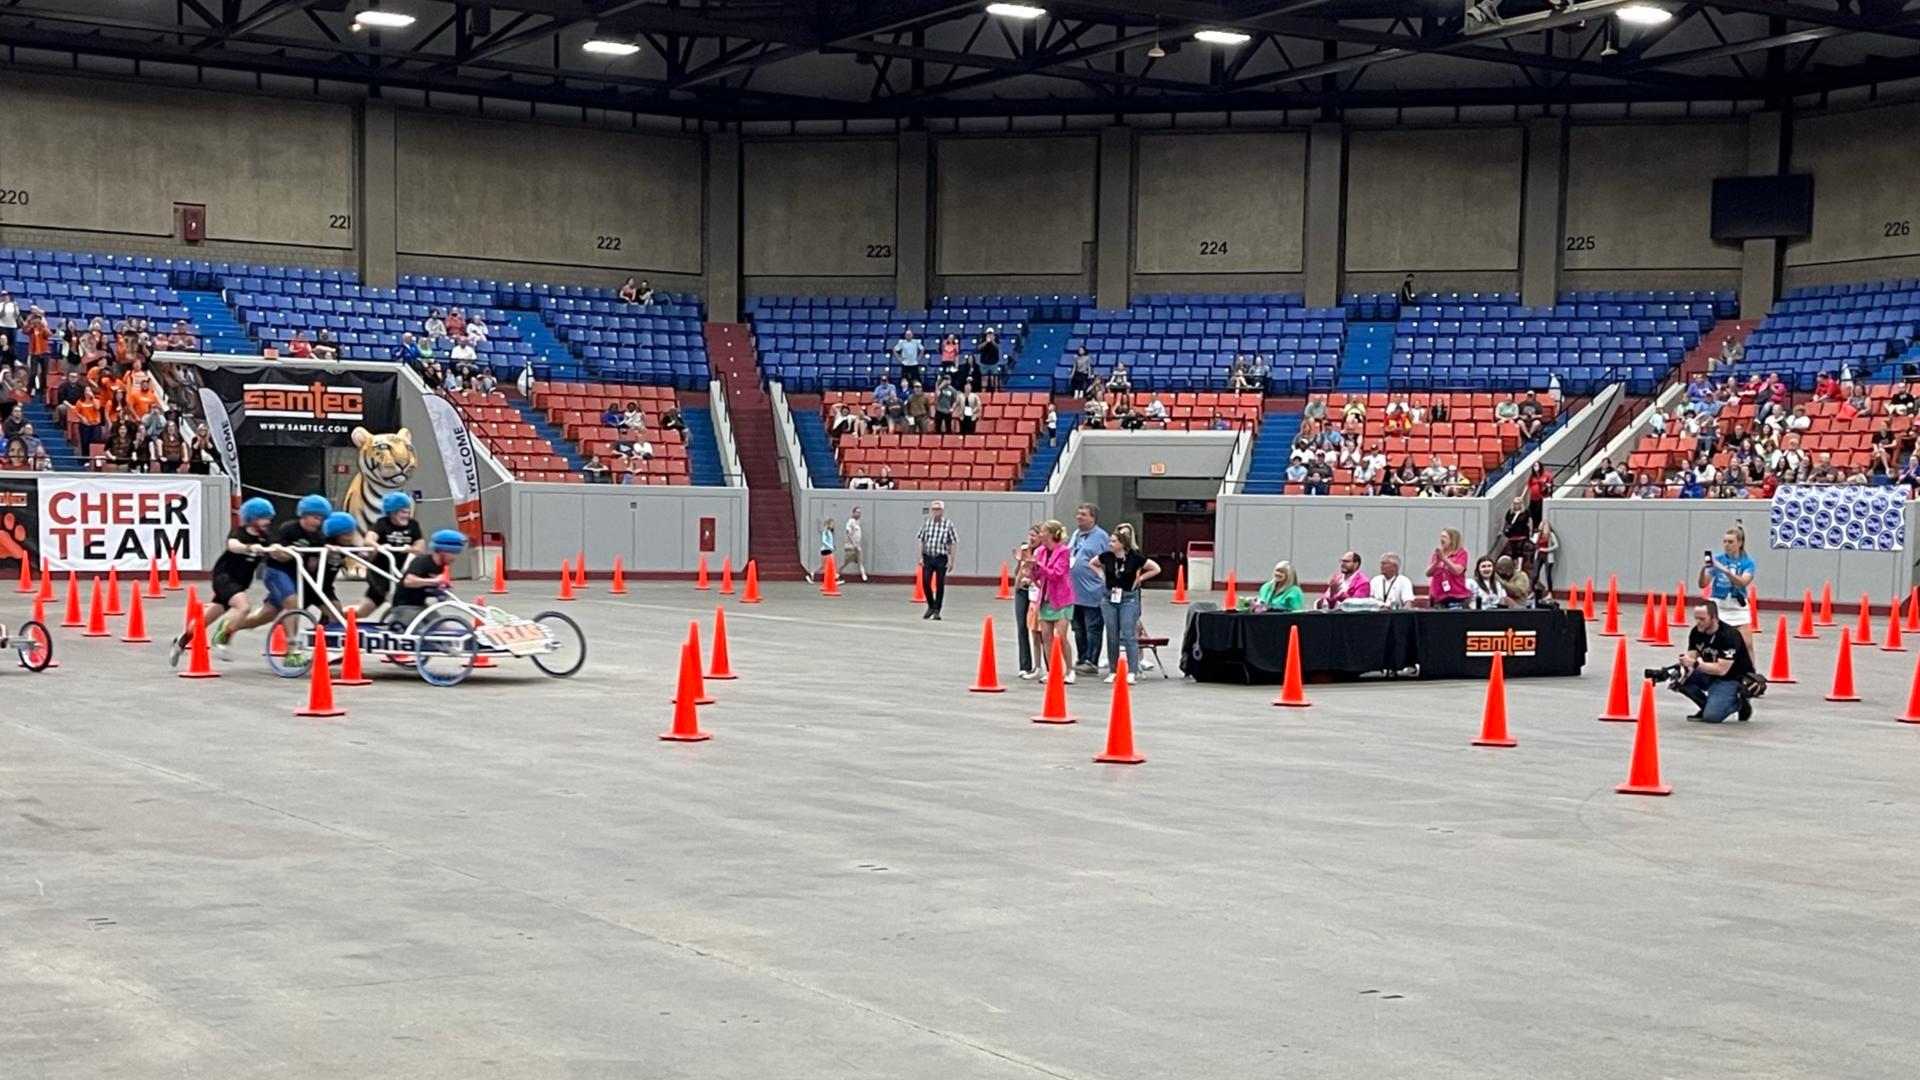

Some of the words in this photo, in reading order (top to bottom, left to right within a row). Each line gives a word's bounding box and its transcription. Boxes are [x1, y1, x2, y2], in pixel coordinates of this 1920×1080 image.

[0, 189, 29, 206] 220
[329, 214, 351, 230] 221
[1884, 220, 1910, 237] 226
[597, 235, 621, 251] 222
[866, 244, 891, 258] 223
[1200, 241, 1228, 255] 224
[1567, 235, 1596, 251] 225
[243, 381, 364, 419] samtec
[259, 422, 349, 434] WWW.SAMTEC.COM
[48, 491, 191, 525] CHEER
[49, 528, 191, 560] TEAM
[1466, 627, 1537, 656] samtec
